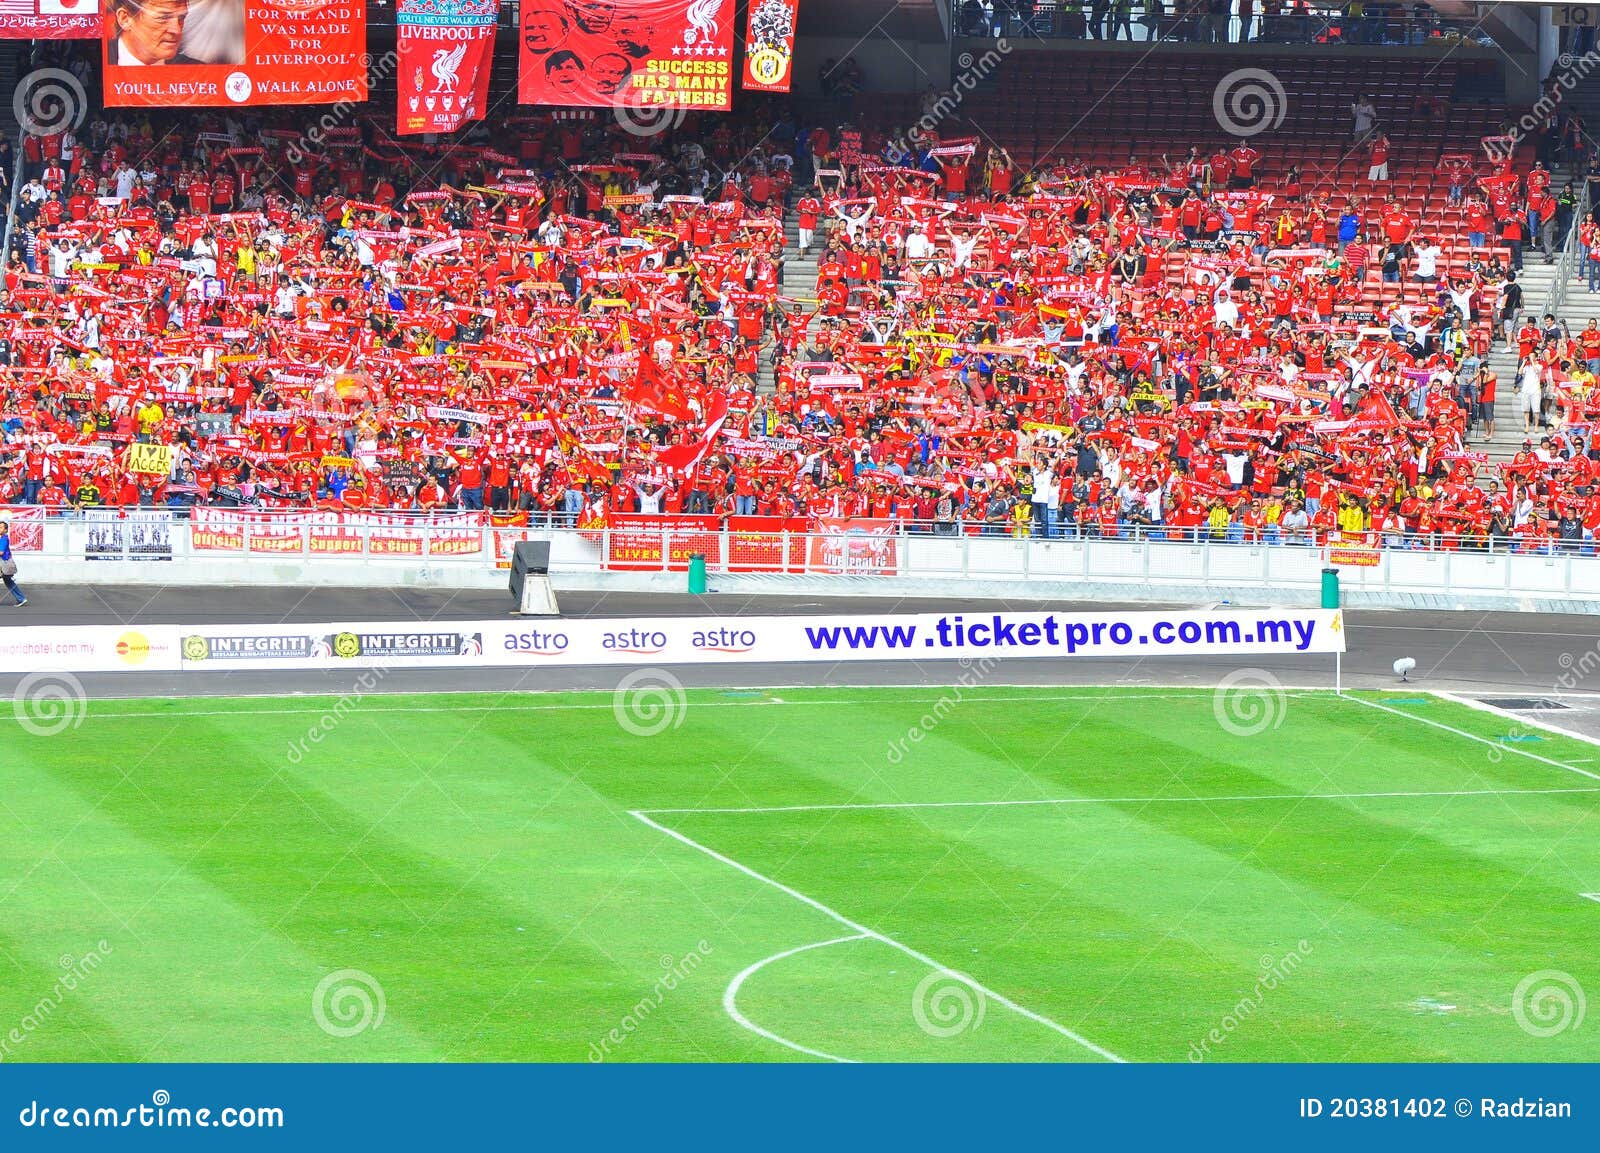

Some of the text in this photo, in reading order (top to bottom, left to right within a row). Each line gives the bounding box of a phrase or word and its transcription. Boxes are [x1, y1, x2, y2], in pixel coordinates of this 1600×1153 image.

[249, 8, 361, 20] FOR ME AND I
[424, 16, 449, 24] NEVER
[1561, 7, 1588, 24] 1Q
[261, 24, 351, 34] WAS MADE
[401, 26, 475, 40] LIVERPOOL
[290, 39, 322, 49] FOR
[646, 60, 728, 75] SUCCESS
[113, 79, 356, 95] YOU'LL NEVER WALK ALONE
[632, 75, 728, 89] HAS MANY
[641, 90, 727, 105] FATHERS
[433, 113, 449, 122] ASIA
[439, 409, 469, 420] LIVERPOOL
[159, 448, 167, 460] U
[131, 458, 170, 472] AGGER
[193, 532, 479, 553] Official iverpoo Supportrs Club alaysia
[615, 549, 698, 559] LIVEROO
[823, 553, 873, 567] LIVEPOOL
[211, 637, 306, 651] INTEGRITI
[362, 634, 456, 648] INTEGRITI
[504, 630, 569, 650] astro
[602, 628, 667, 648] astro
[691, 627, 756, 647] astro
